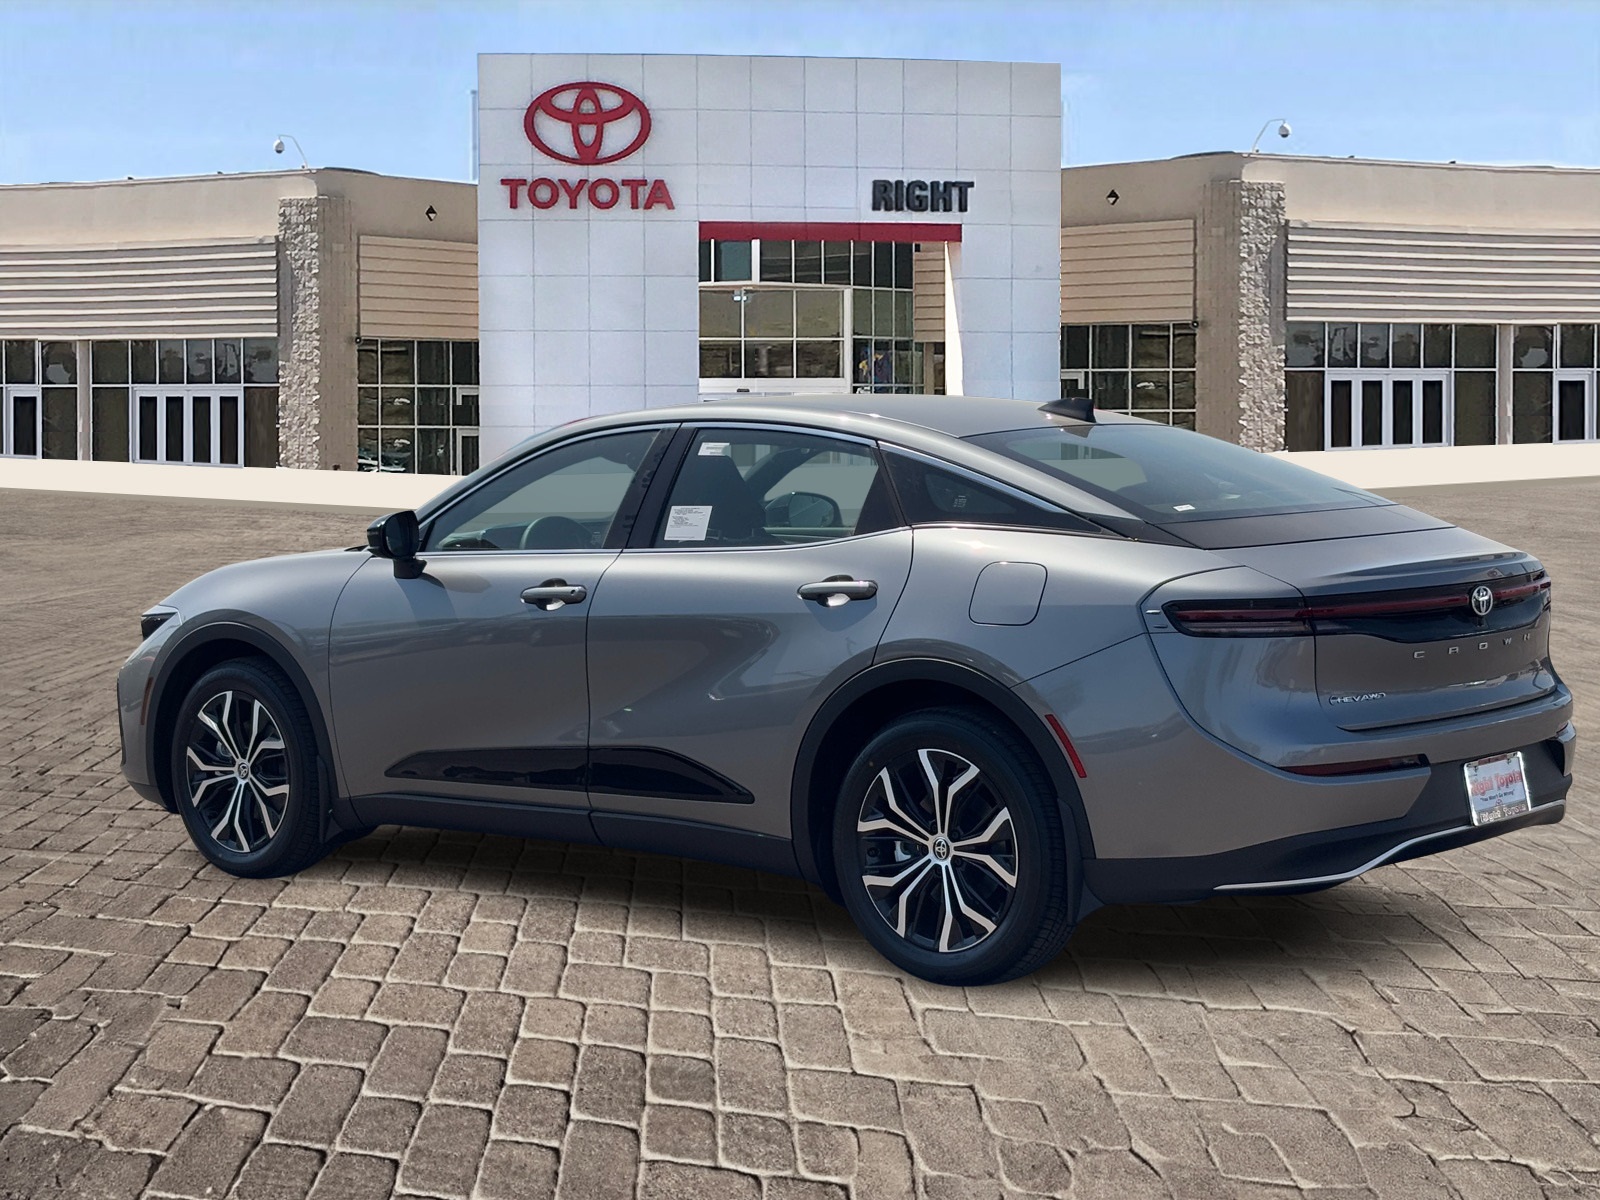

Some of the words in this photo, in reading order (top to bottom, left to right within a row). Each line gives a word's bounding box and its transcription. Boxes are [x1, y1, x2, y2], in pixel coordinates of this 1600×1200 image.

[500, 177, 675, 210] TOYOTA
[872, 180, 975, 212] RIGHT
[1413, 633, 1531, 659] CROWN
[1495, 771, 1522, 789] Toyota
